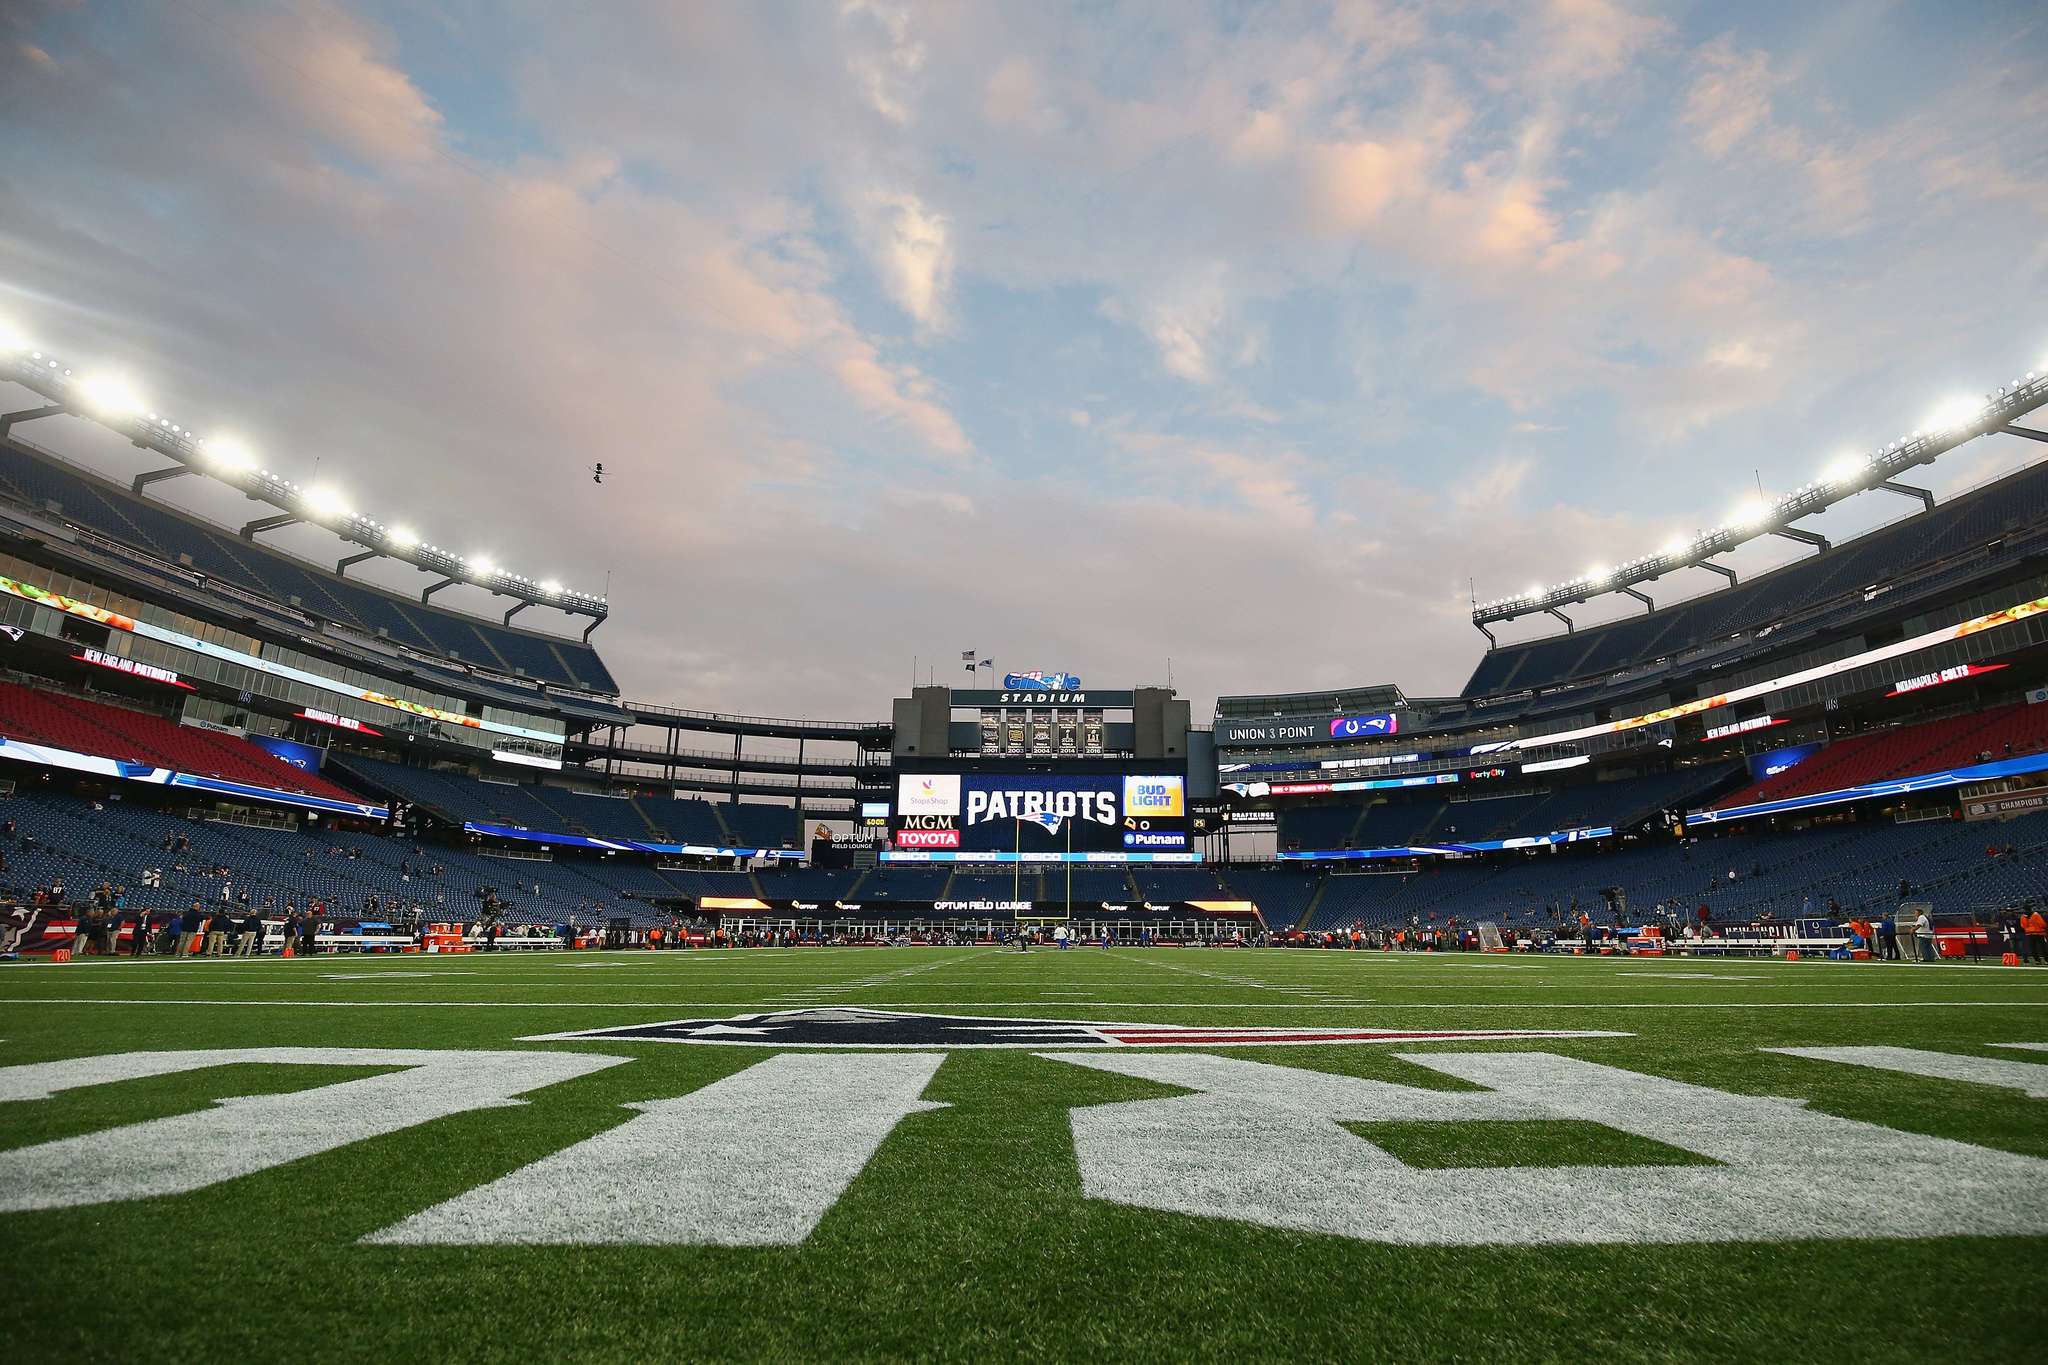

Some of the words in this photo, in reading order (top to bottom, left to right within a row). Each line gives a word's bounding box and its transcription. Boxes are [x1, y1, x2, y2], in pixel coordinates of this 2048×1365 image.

[84, 648, 102, 664] NEW
[102, 653, 134, 672] ENGLAND
[134, 663, 177, 683] PATRIOTS
[1004, 672, 1081, 691] Gillette
[1895, 672, 1939, 693] INDIANAPOLIS
[1940, 664, 1969, 681] COLTS
[1000, 693, 1085, 703] STADIUM
[1229, 728, 1265, 740] UNION
[1279, 726, 1315, 738] POINT
[1707, 728, 1718, 738] NEW
[1740, 715, 1772, 731] PATRIOTS
[1137, 785, 1166, 795] BUD
[1133, 796, 1171, 806] LIGHT
[2000, 797, 2043, 810] CHAMPIONS
[967, 790, 1116, 826] PATRIOTS
[904, 815, 953, 829] MGM
[832, 833, 874, 843] OPTUM
[899, 833, 957, 844] TOYOTA
[1135, 834, 1185, 845] Putnam
[934, 901, 967, 910] OPTUM
[968, 901, 994, 910] FIELD
[995, 901, 1032, 910] LOUNGE
